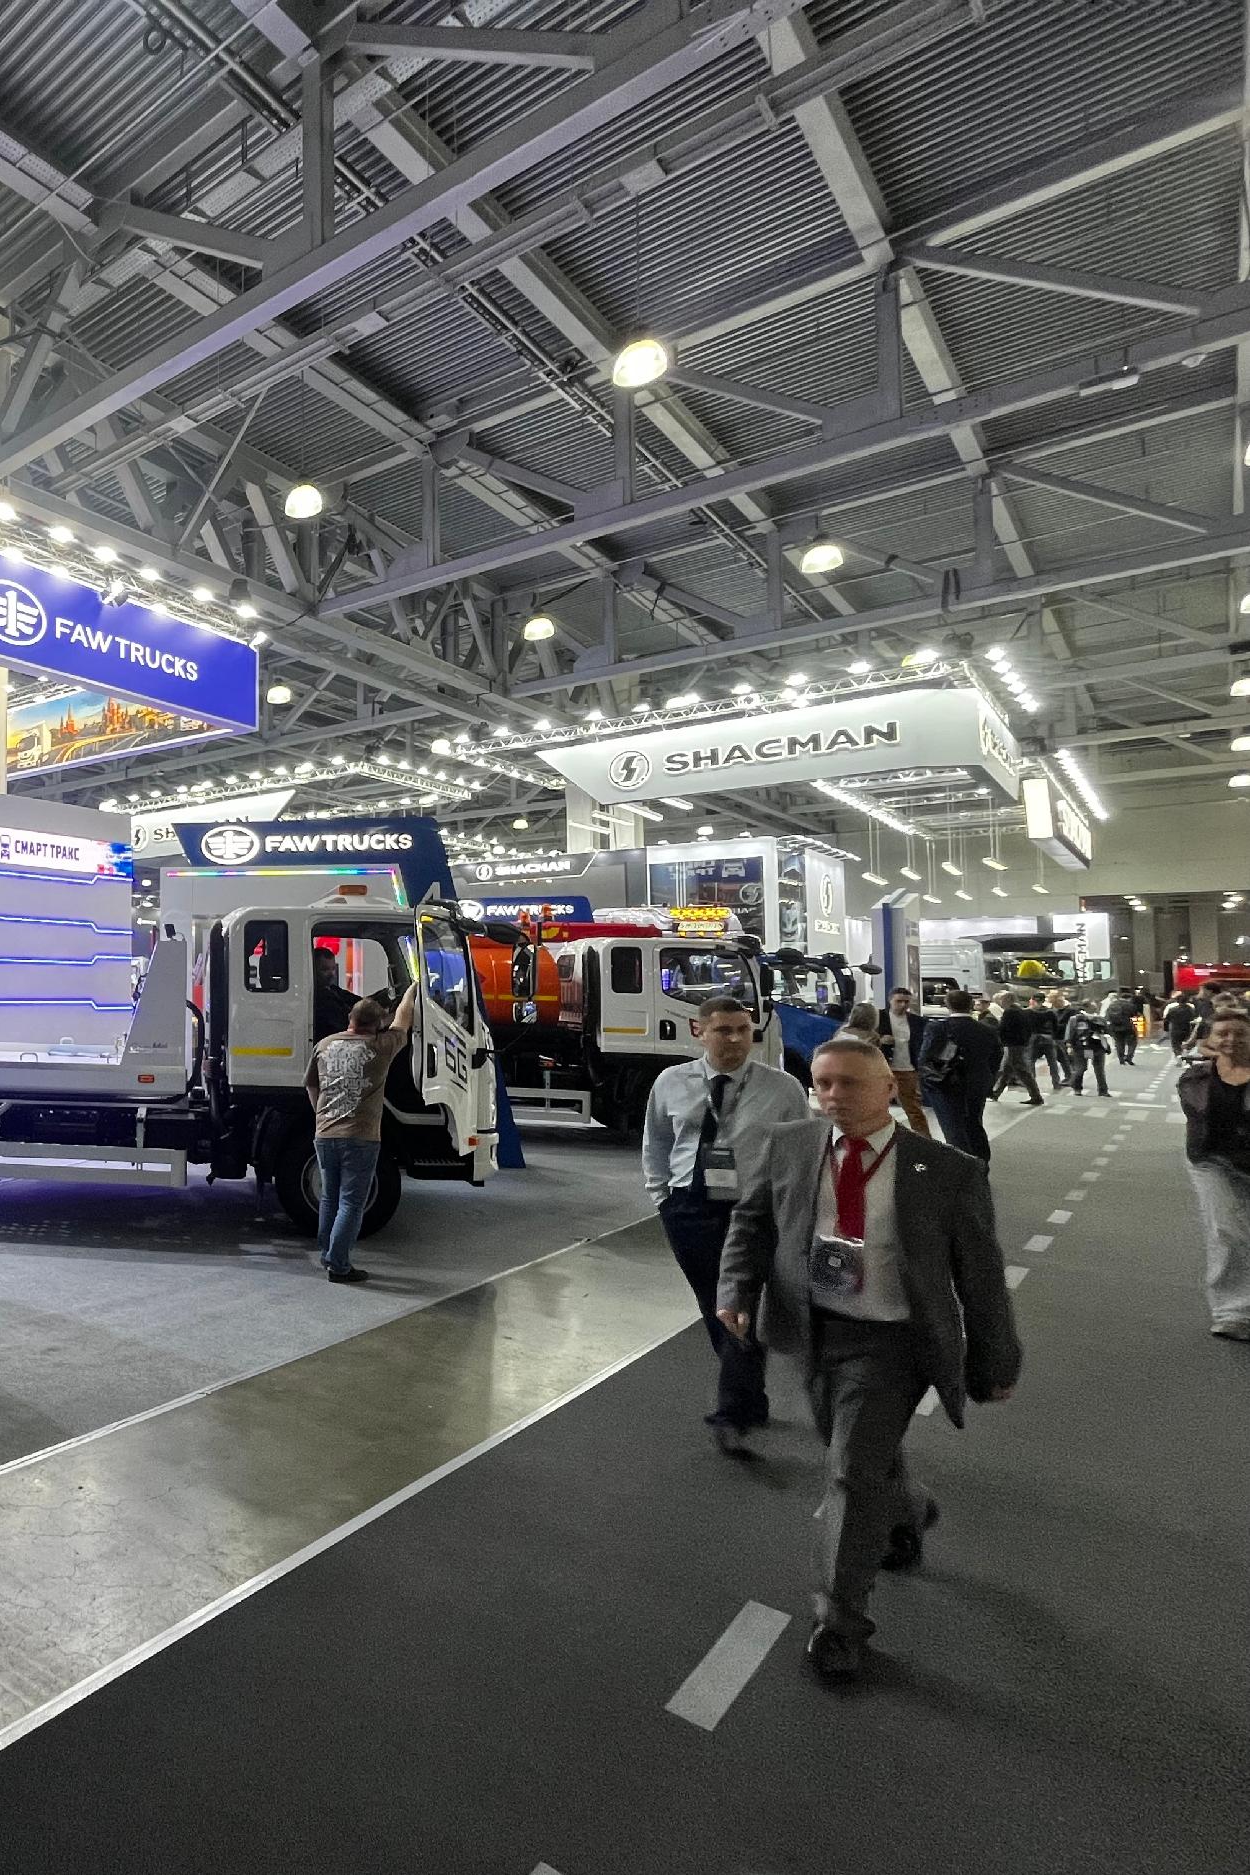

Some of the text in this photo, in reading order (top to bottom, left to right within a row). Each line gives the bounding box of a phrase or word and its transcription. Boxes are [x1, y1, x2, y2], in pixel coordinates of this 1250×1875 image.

[55, 617, 199, 682] FAW TRUCKS
[663, 720, 900, 775] SHACMAN
[14, 839, 80, 861] СМАРТ ТРАКС
[264, 832, 413, 852] FAW TRUCKS
[494, 860, 571, 876] SHACMAN
[486, 904, 519, 917] FAW
